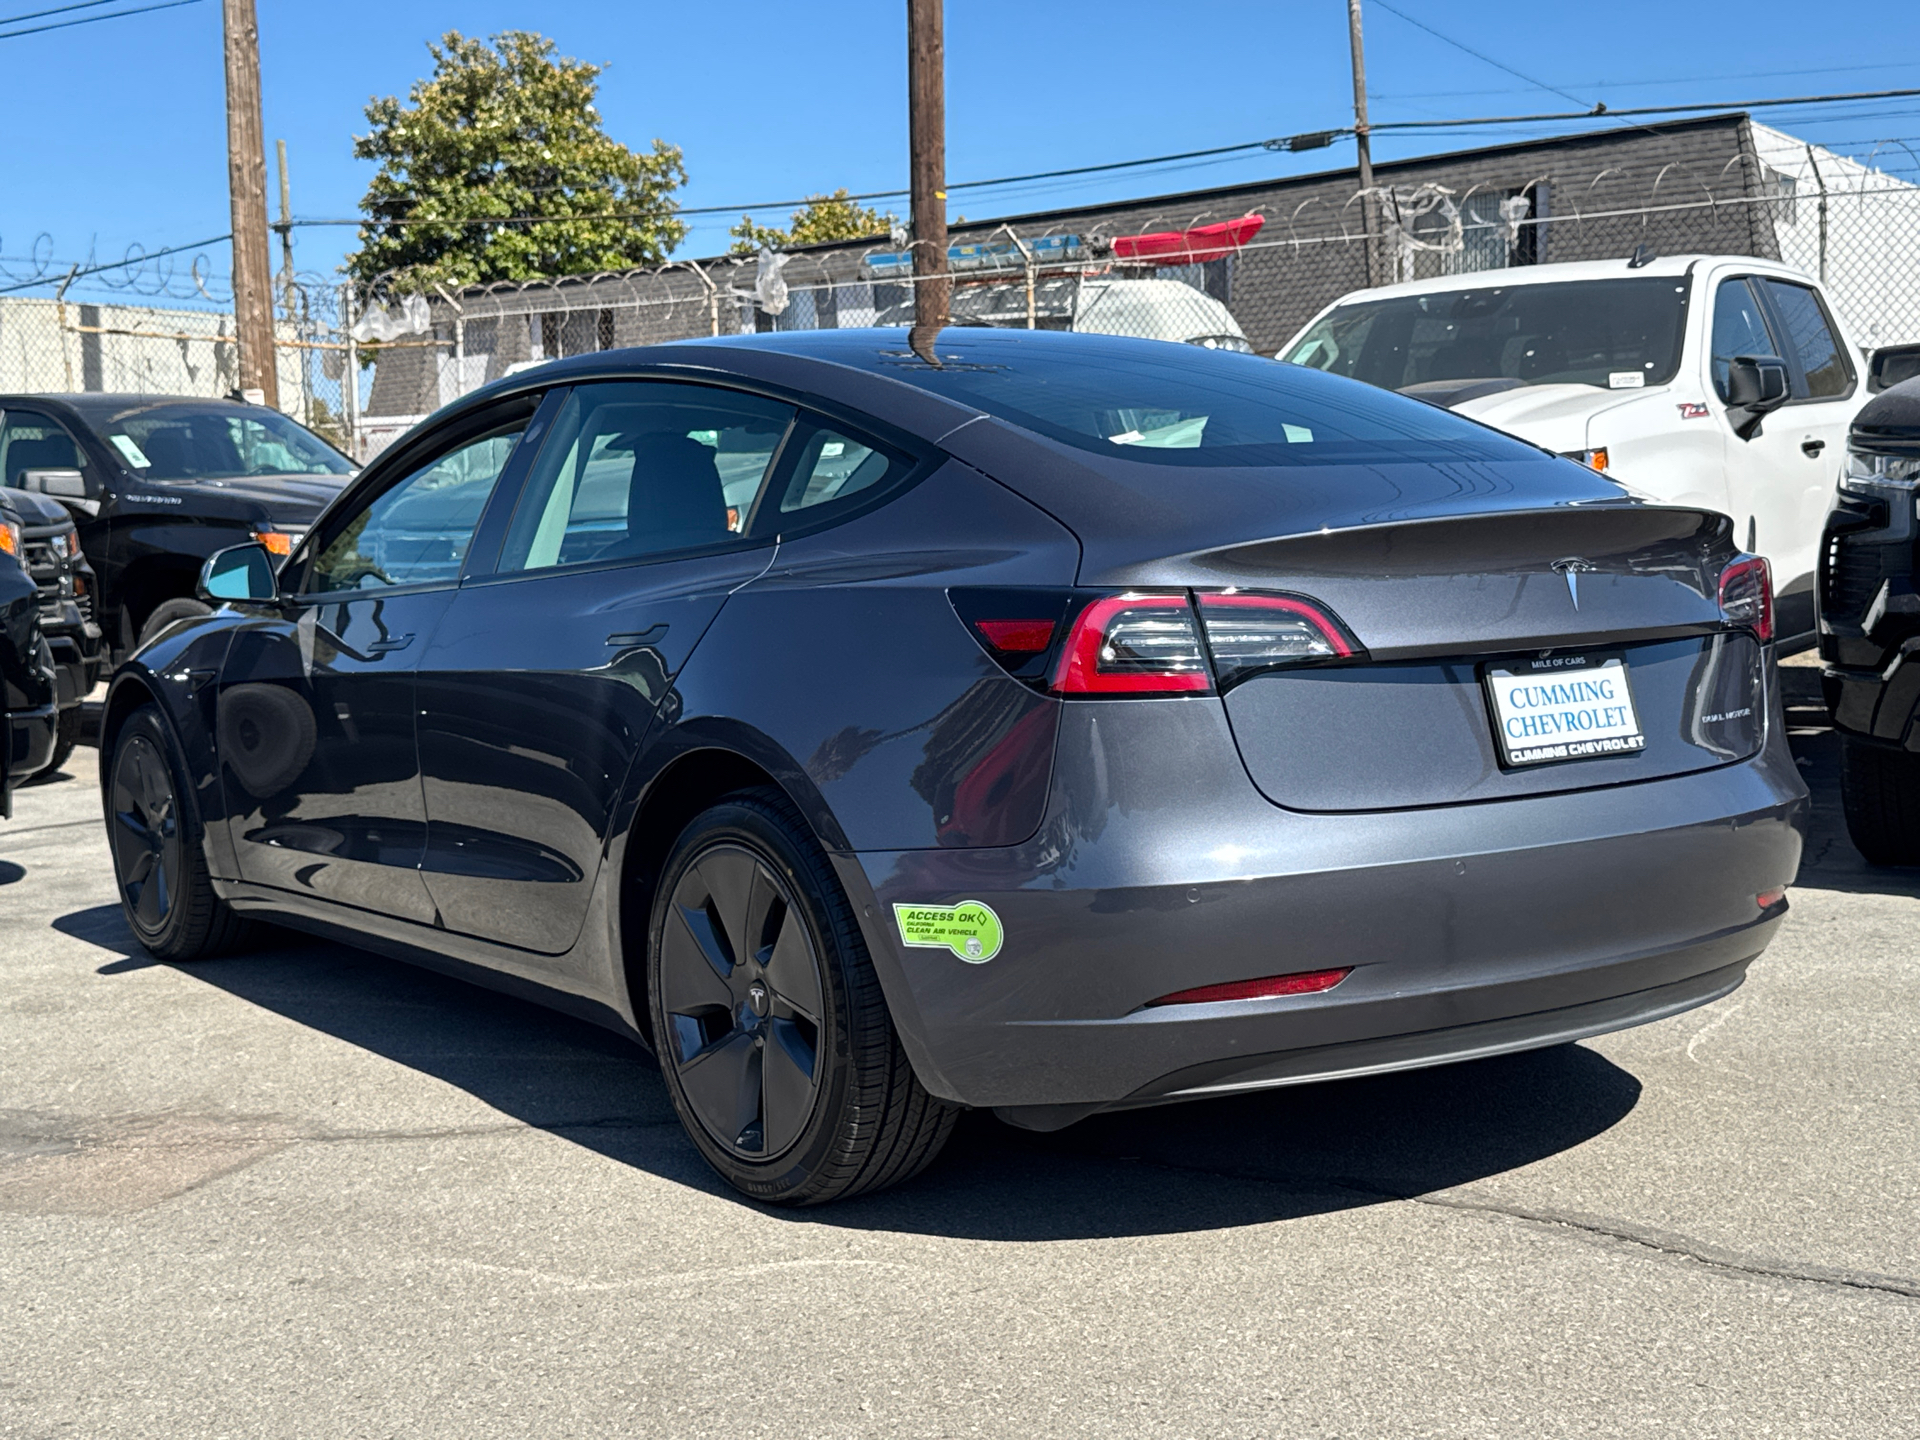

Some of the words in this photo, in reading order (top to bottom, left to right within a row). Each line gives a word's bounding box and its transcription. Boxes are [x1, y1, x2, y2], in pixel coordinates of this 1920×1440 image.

[1531, 660, 1553, 669] MILE
[1552, 659, 1563, 667] OF
[1564, 657, 1586, 665] CARS
[1509, 679, 1614, 709] CUMMING
[1506, 706, 1628, 738] CHEVROLET
[1701, 713, 1725, 723] DUAL
[1725, 708, 1751, 720] MOTOR
[1510, 745, 1568, 762] CUMMING
[1568, 736, 1644, 756] CHEVROLET
[907, 911, 955, 921] ACCESS
[958, 913, 976, 923] OK
